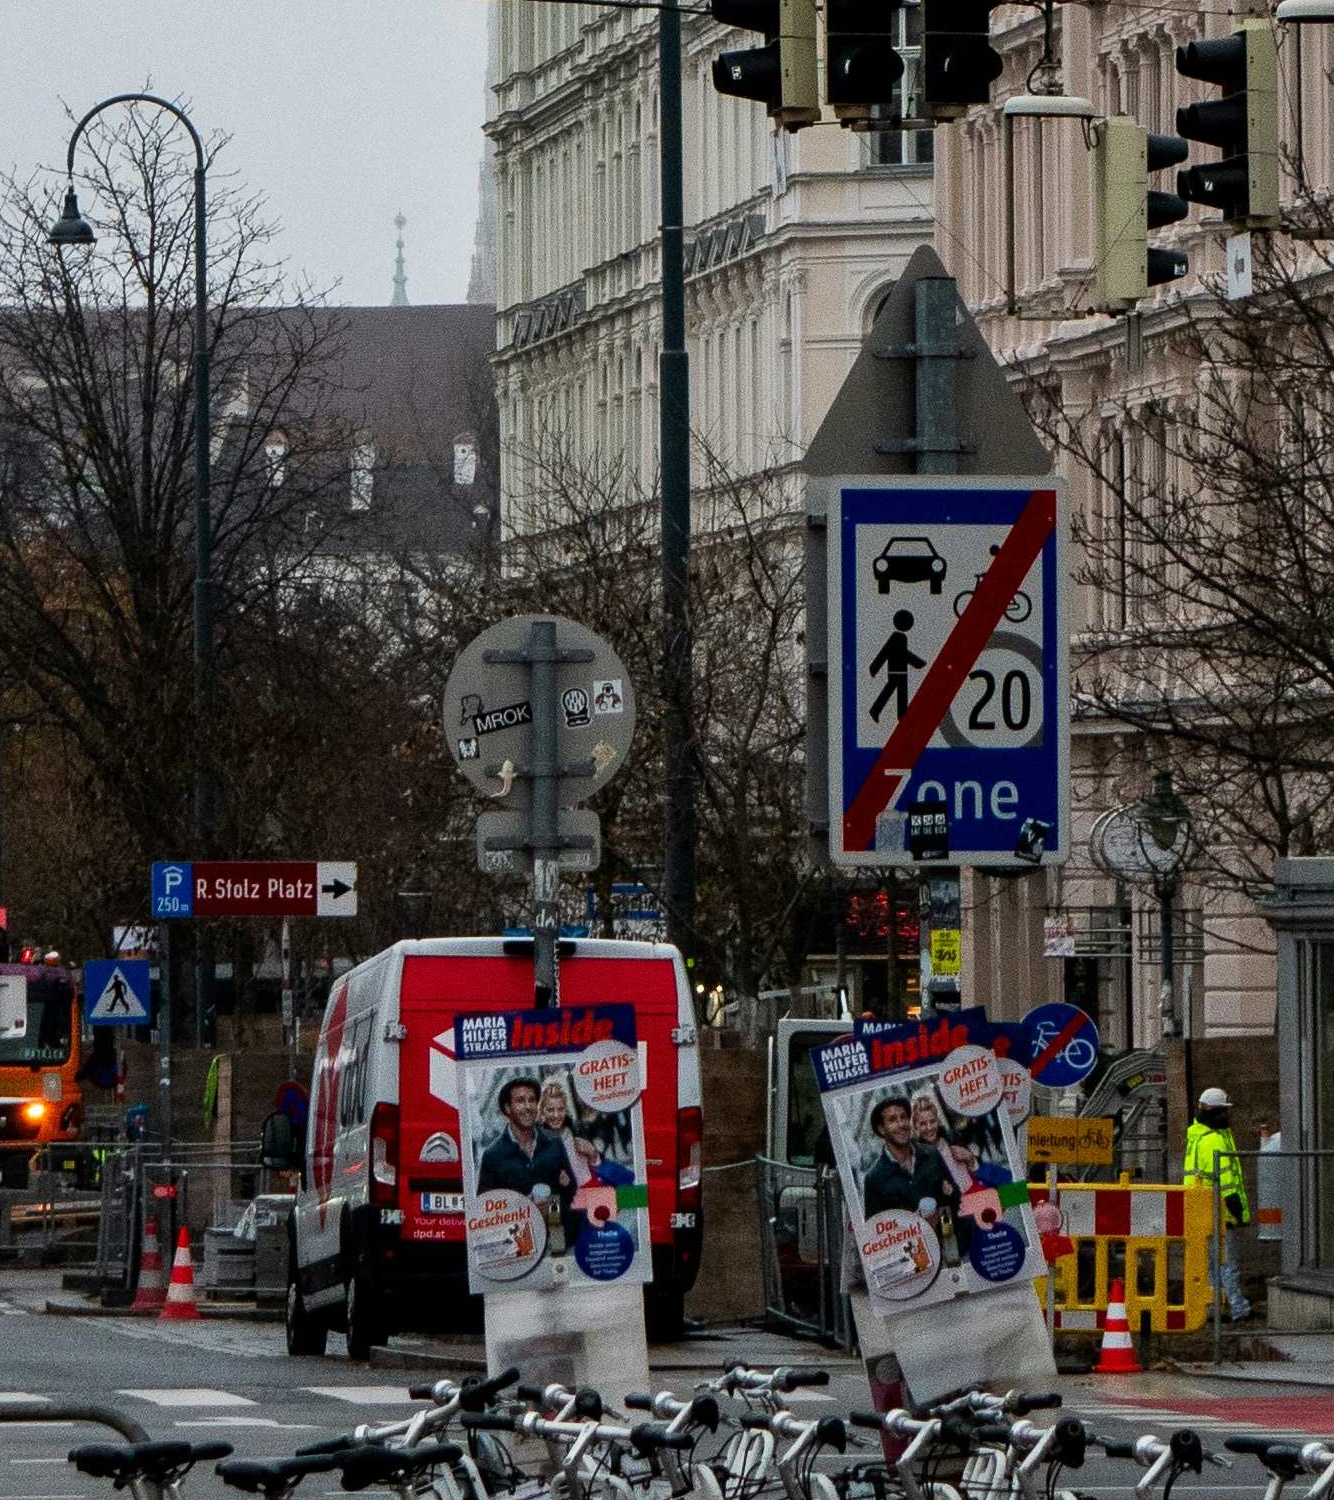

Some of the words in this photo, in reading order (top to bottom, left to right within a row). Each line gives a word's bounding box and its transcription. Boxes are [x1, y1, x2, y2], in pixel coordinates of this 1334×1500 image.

[966, 668, 1032, 732] 20
[475, 703, 531, 735] MROK
[883, 768, 1020, 820] Zone
[268, 877, 313, 899] Platz
[157, 896, 179, 912] 250
[462, 1015, 507, 1031] MARIA
[510, 1009, 615, 1049] Inside
[463, 1027, 507, 1043] HILFER
[871, 1018, 970, 1071] Inside
[463, 1040, 507, 1053] STRASSE
[820, 1040, 865, 1062] MARIA
[578, 1053, 636, 1077] GRATIS-
[823, 1052, 868, 1075] HILFER
[942, 1055, 993, 1085] GRATIS-
[592, 1071, 628, 1092] HEFT
[825, 1066, 870, 1084] STRASSE
[957, 1073, 990, 1098] HEFT
[434, 1195, 451, 1210] BL
[484, 1199, 508, 1213] Das
[413, 1216, 437, 1227] Your
[468, 1207, 531, 1231] Geschenk!
[874, 1218, 899, 1236] Das
[413, 1229, 446, 1240] dpd.at
[861, 1221, 923, 1257] Geschenk!
